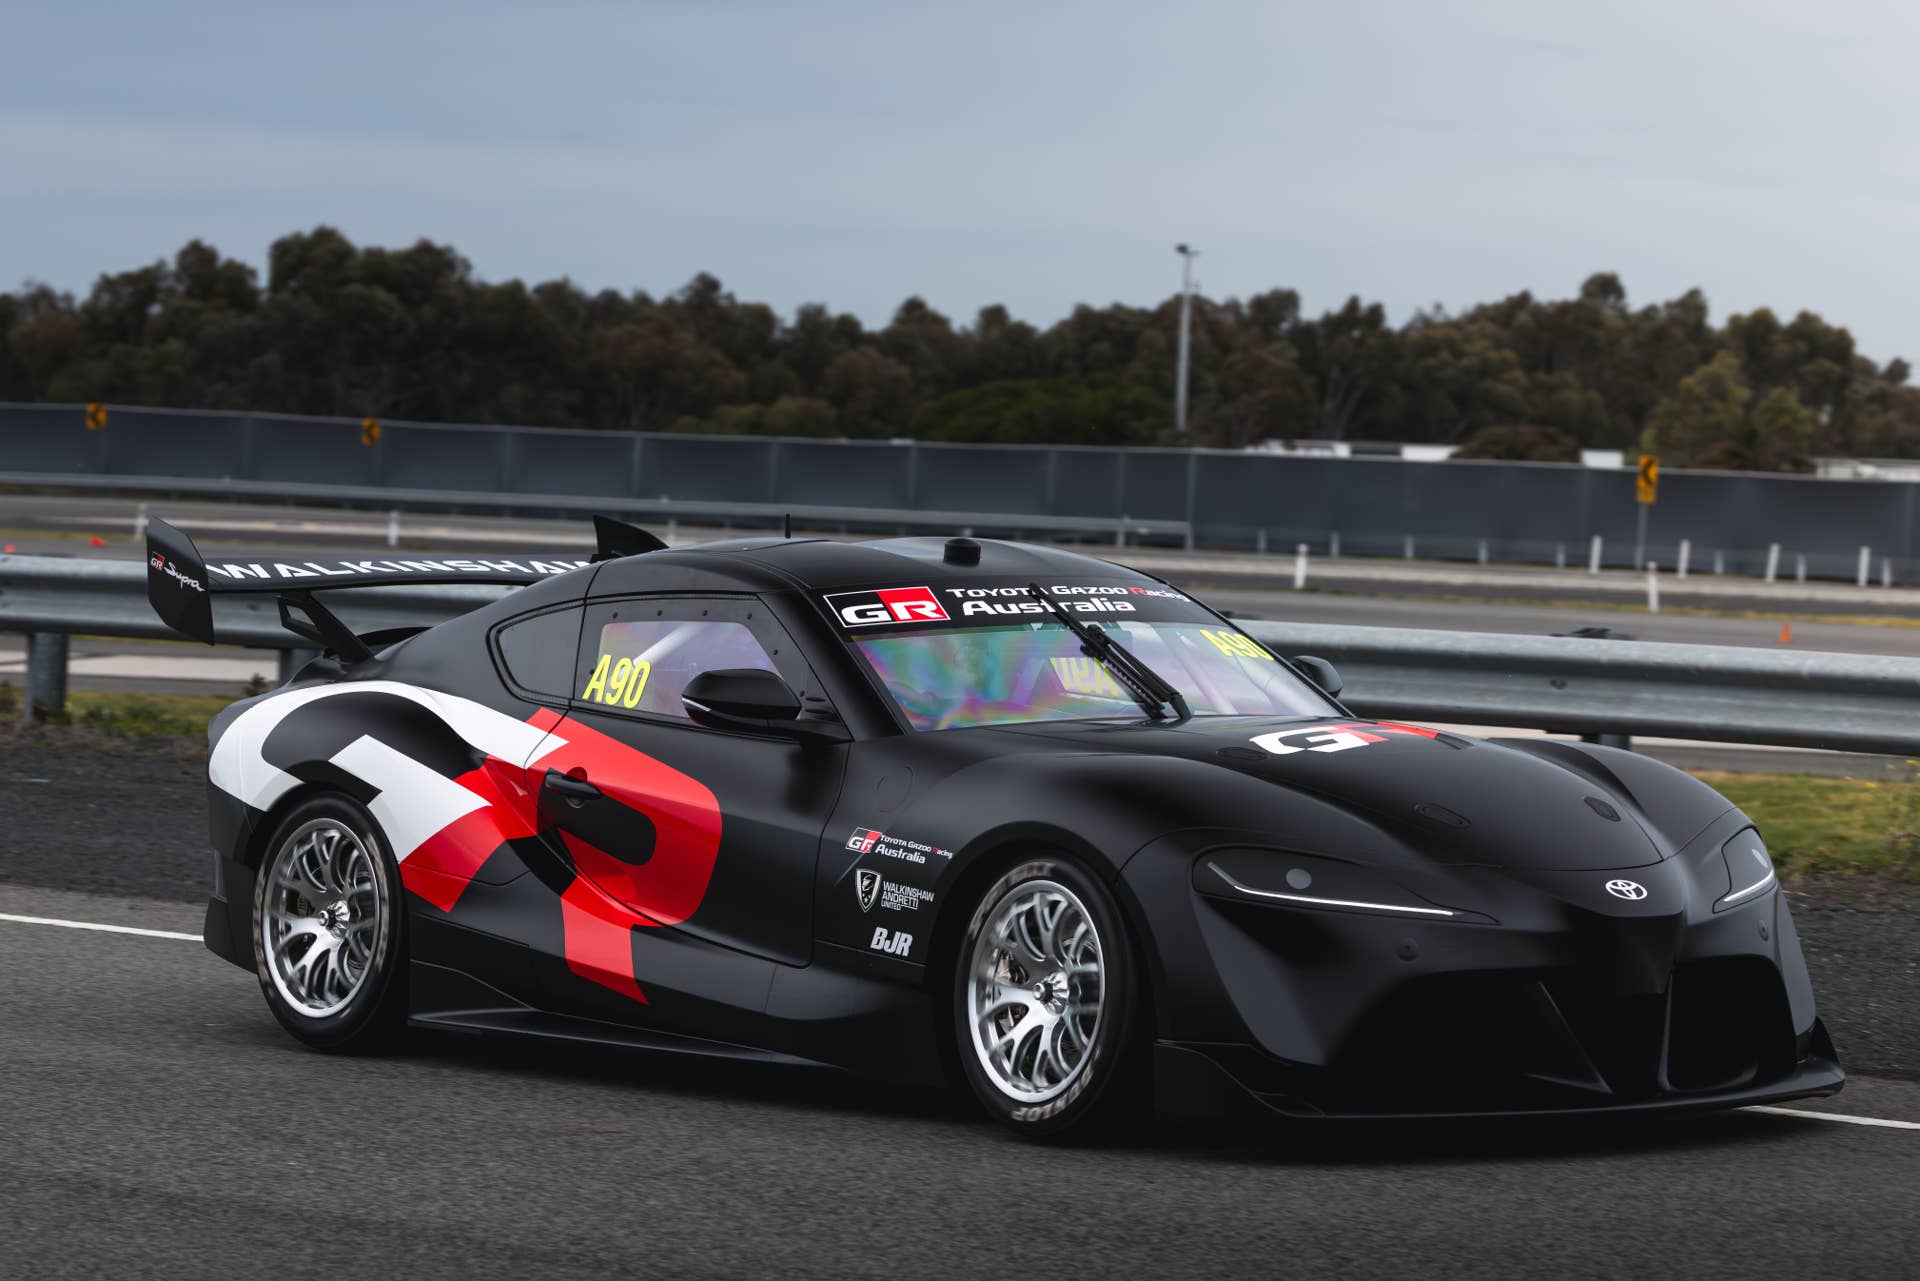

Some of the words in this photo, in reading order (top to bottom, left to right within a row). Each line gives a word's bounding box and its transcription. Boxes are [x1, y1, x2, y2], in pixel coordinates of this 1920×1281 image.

[150, 557, 163, 571] GR
[163, 561, 206, 592] Supra
[1052, 585, 1127, 596] GAZOO
[1129, 586, 1191, 602] Racing
[841, 600, 945, 624] GR
[963, 597, 1136, 617] Australia
[1199, 629, 1274, 662] A90
[582, 653, 651, 709] A90
[848, 836, 876, 852] GR
[875, 844, 926, 864] Australia
[880, 834, 907, 847] TOYOTA
[907, 840, 932, 853] GAZOO
[931, 846, 954, 860] Racing
[881, 891, 919, 908] ANDRETTI
[883, 880, 935, 902] WALKINSHAW
[880, 899, 902, 911] UNITED
[870, 926, 913, 957] BJR
